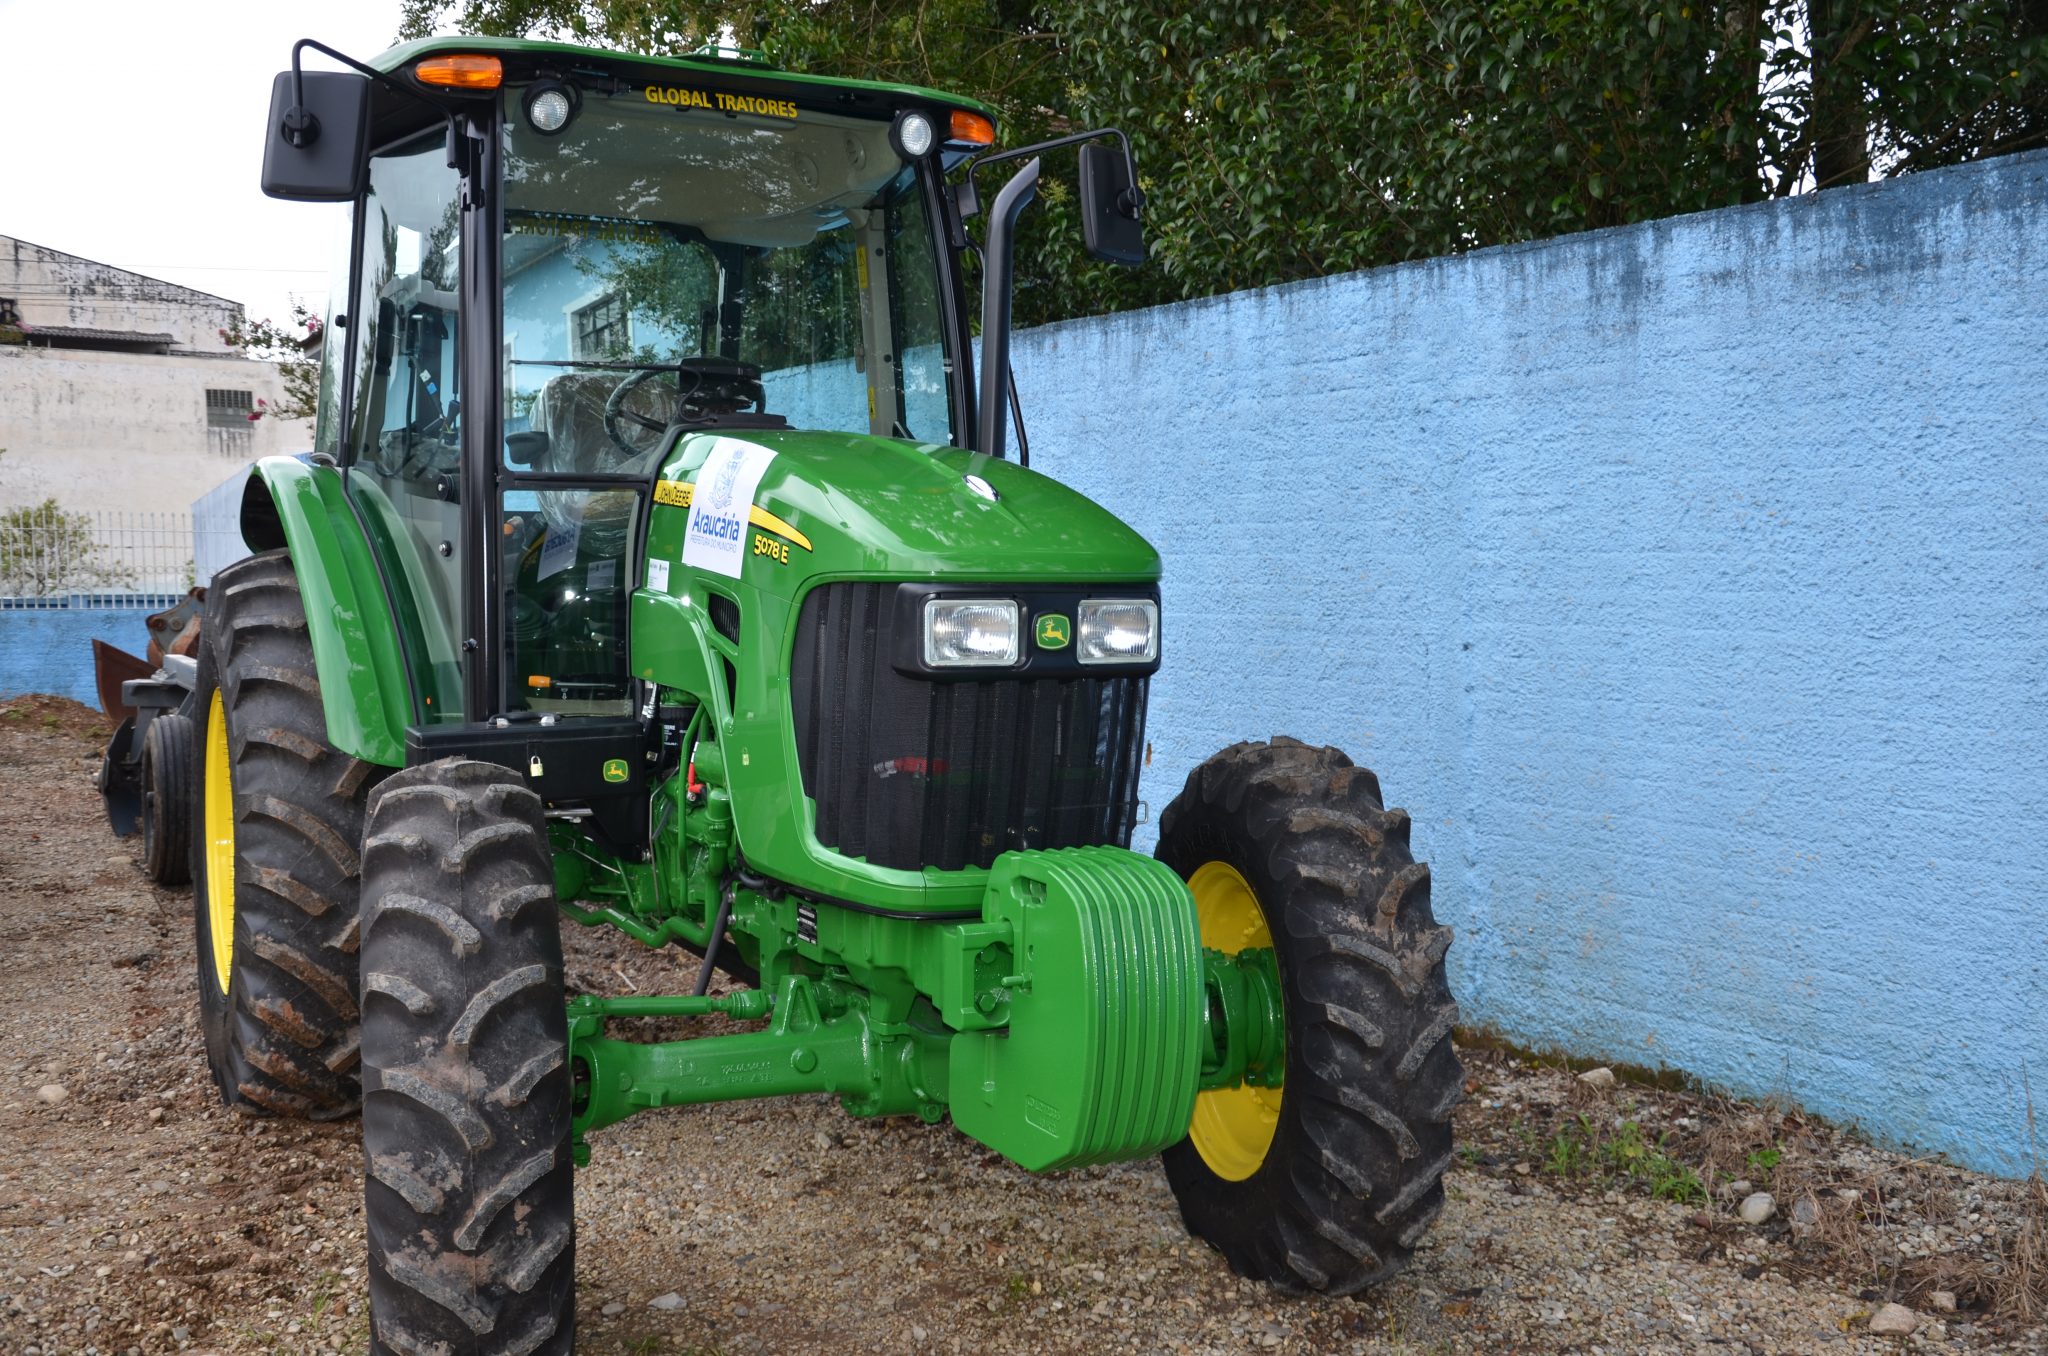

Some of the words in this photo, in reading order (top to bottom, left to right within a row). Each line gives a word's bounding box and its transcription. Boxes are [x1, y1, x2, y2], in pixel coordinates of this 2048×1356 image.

[645, 86, 712, 108] GLOBAL
[715, 93, 798, 118] TRATORES
[672, 486, 691, 506] DEERE
[692, 507, 740, 541] Araucária
[753, 534, 780, 559] 5078
[780, 544, 790, 565] E
